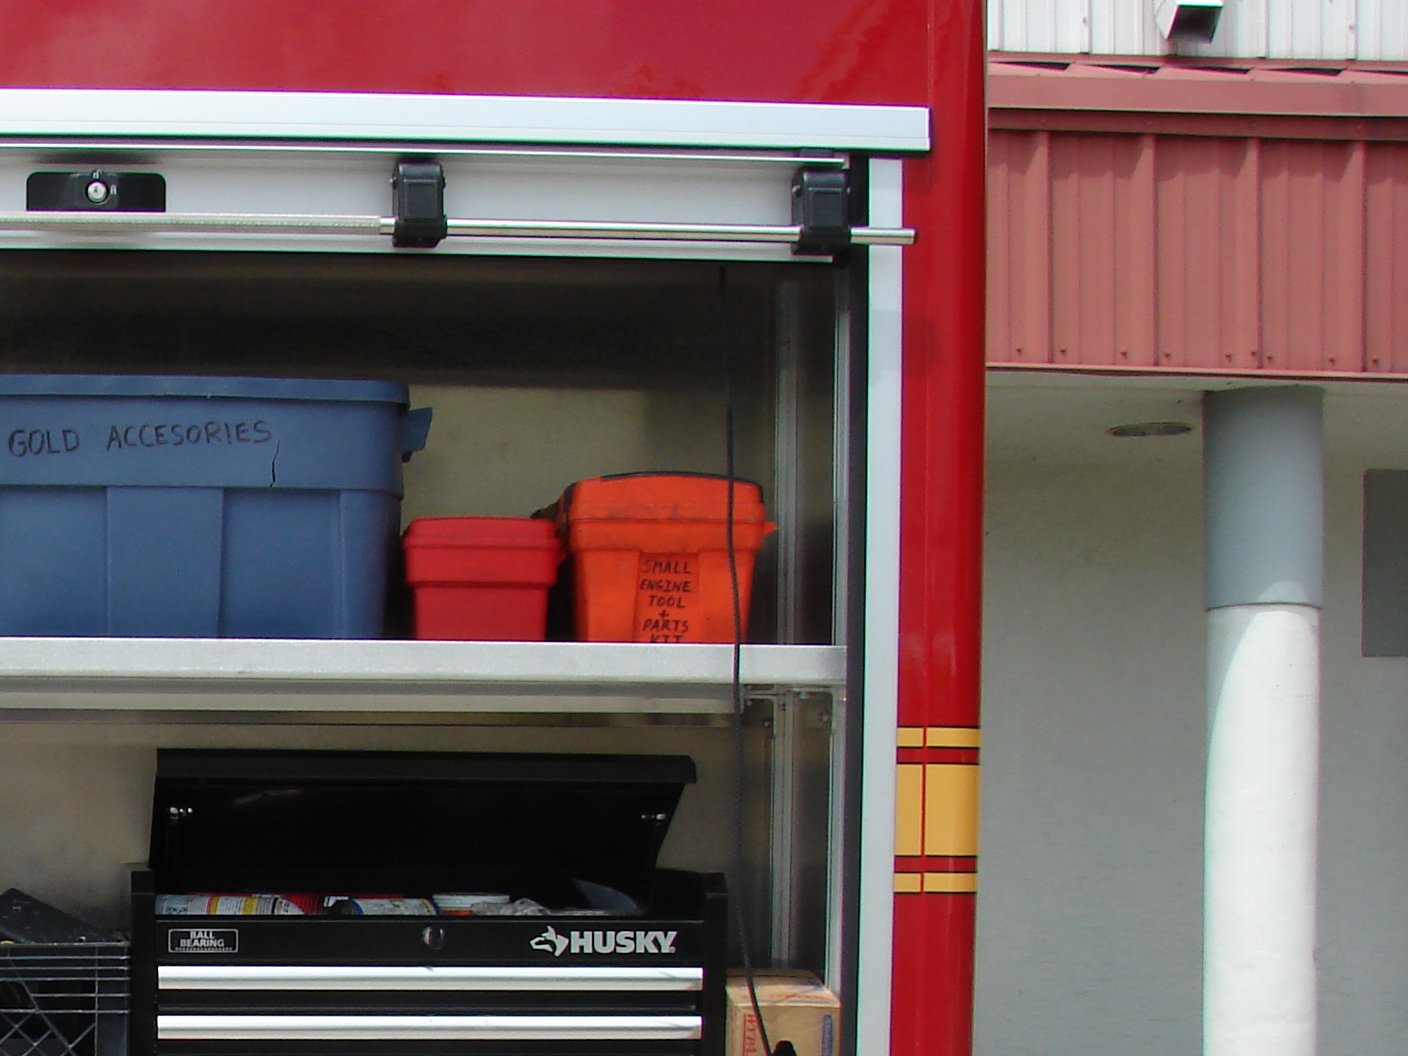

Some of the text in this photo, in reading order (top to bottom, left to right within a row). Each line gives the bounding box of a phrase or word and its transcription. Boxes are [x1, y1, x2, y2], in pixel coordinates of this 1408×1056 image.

[8, 420, 272, 458] GOLD ACCESORIES
[643, 559, 693, 575] SMALL
[639, 578, 691, 593] ENGINE
[648, 595, 686, 609] TOOL
[642, 618, 690, 634] PARTS
[189, 931, 215, 939] BALL
[569, 930, 678, 954] HUSKY
[179, 939, 225, 947] BEARING
